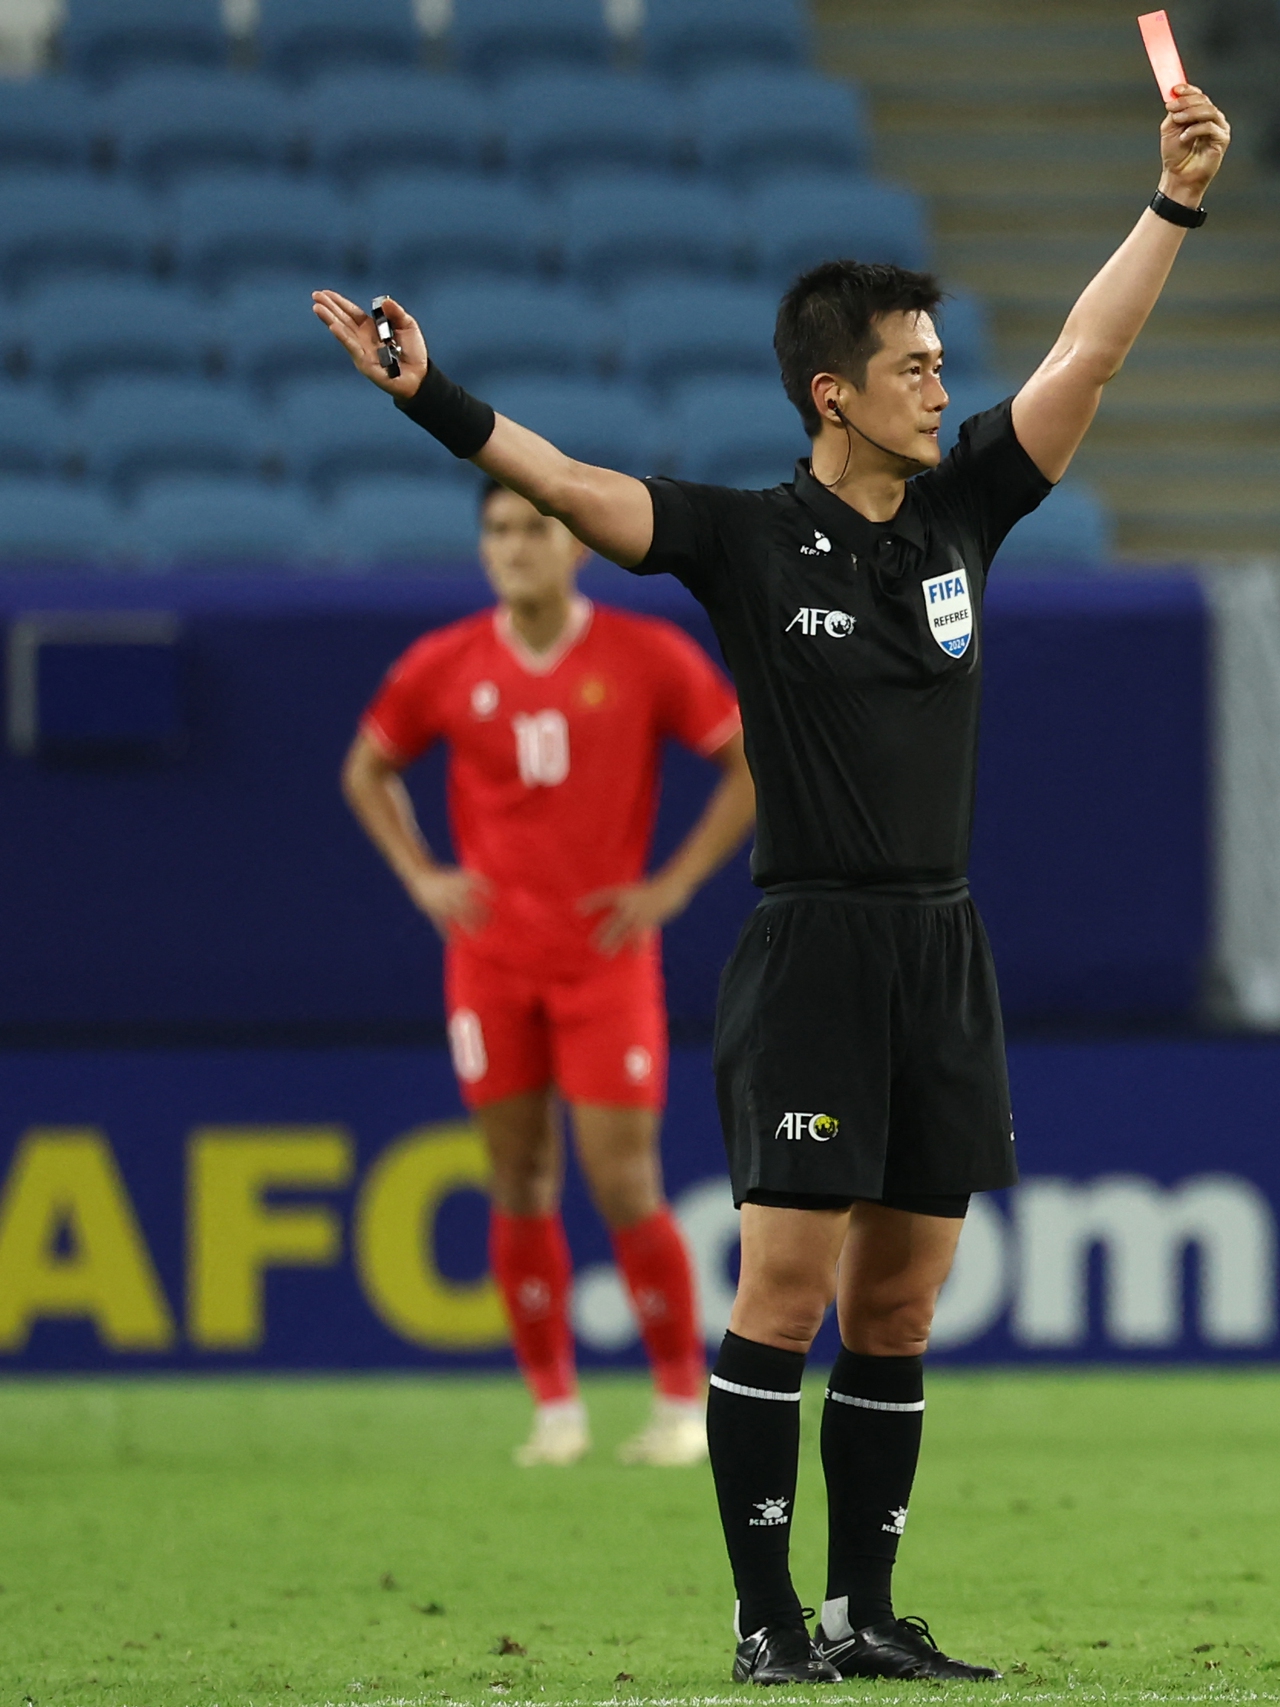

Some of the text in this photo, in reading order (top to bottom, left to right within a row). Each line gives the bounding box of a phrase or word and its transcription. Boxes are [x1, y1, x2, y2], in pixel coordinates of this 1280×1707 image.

[928, 577, 965, 604] FIFA
[785, 607, 857, 638] AFC
[933, 608, 970, 628] REFEREE
[948, 638, 966, 651] 2024
[511, 708, 571, 788] 10
[775, 1112, 840, 1142] AFC
